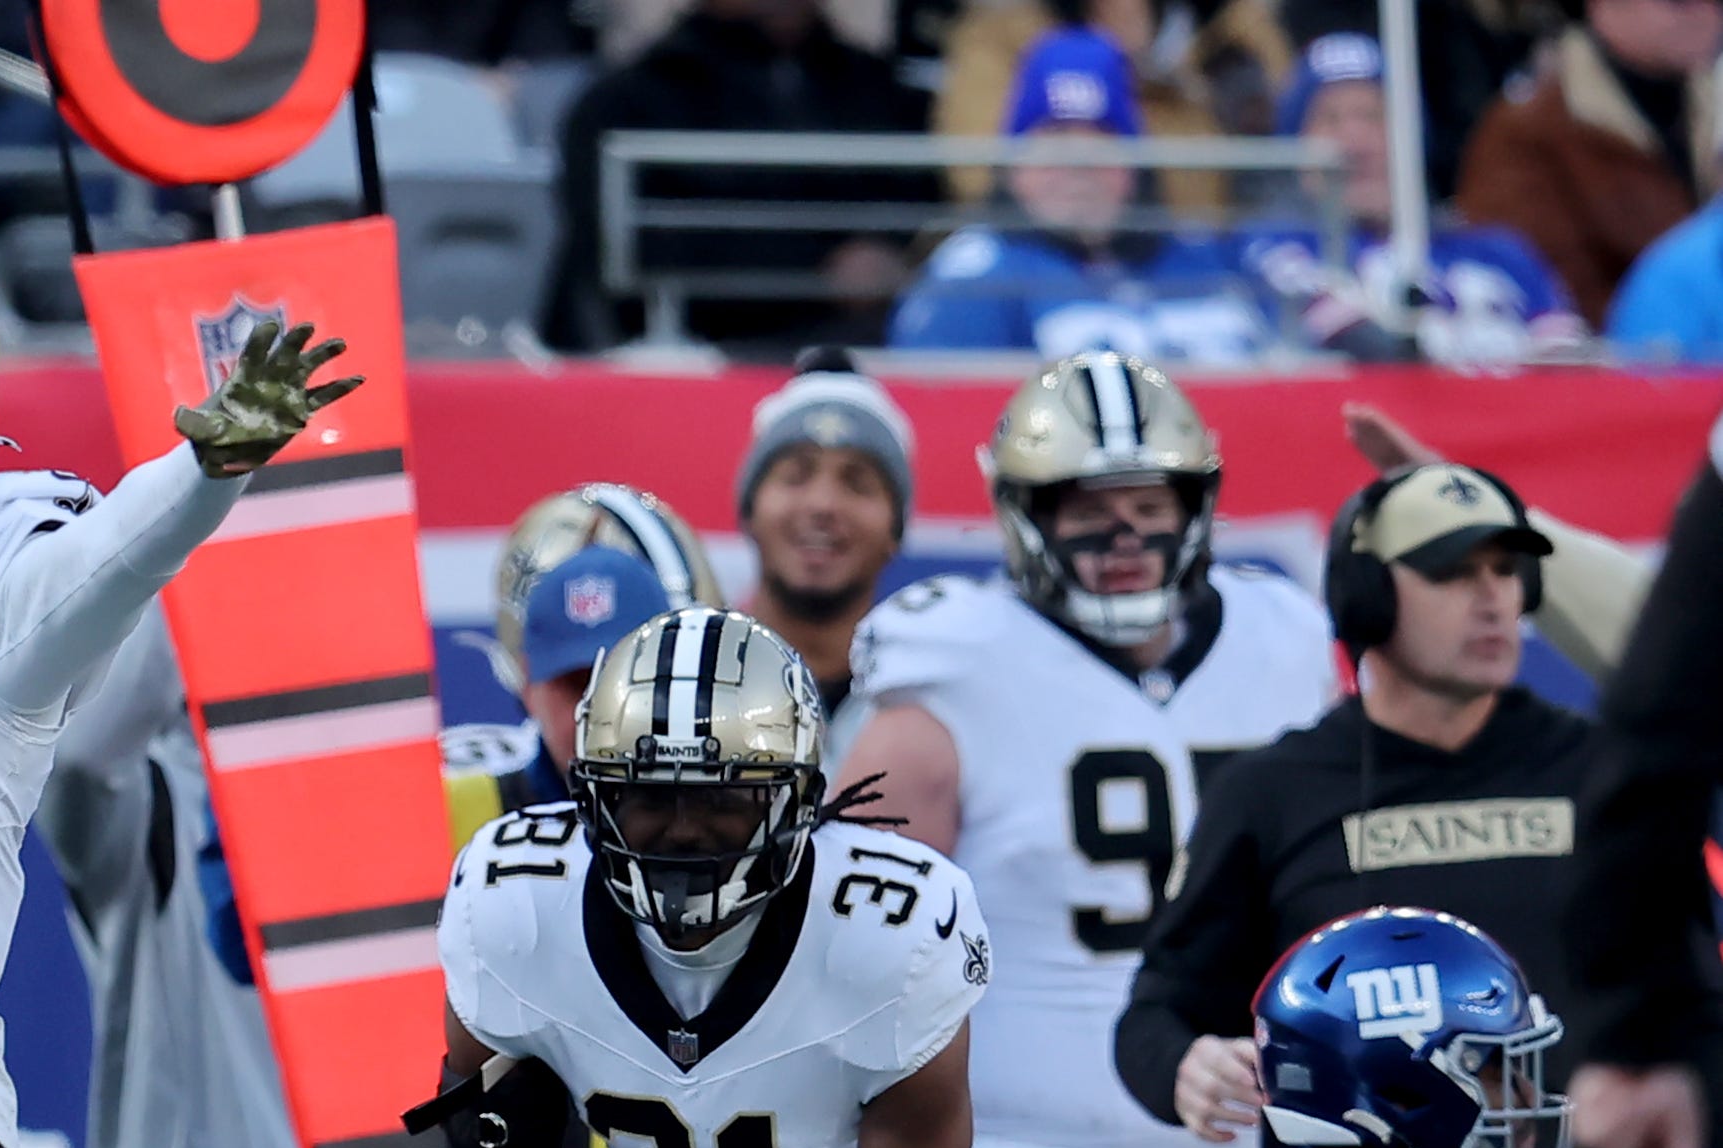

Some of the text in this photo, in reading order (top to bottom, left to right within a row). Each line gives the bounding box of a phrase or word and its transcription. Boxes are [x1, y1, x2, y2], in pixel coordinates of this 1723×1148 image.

[657, 744, 700, 758] SAINTS
[1366, 808, 1554, 859] SAINTS
[829, 844, 934, 930] 31
